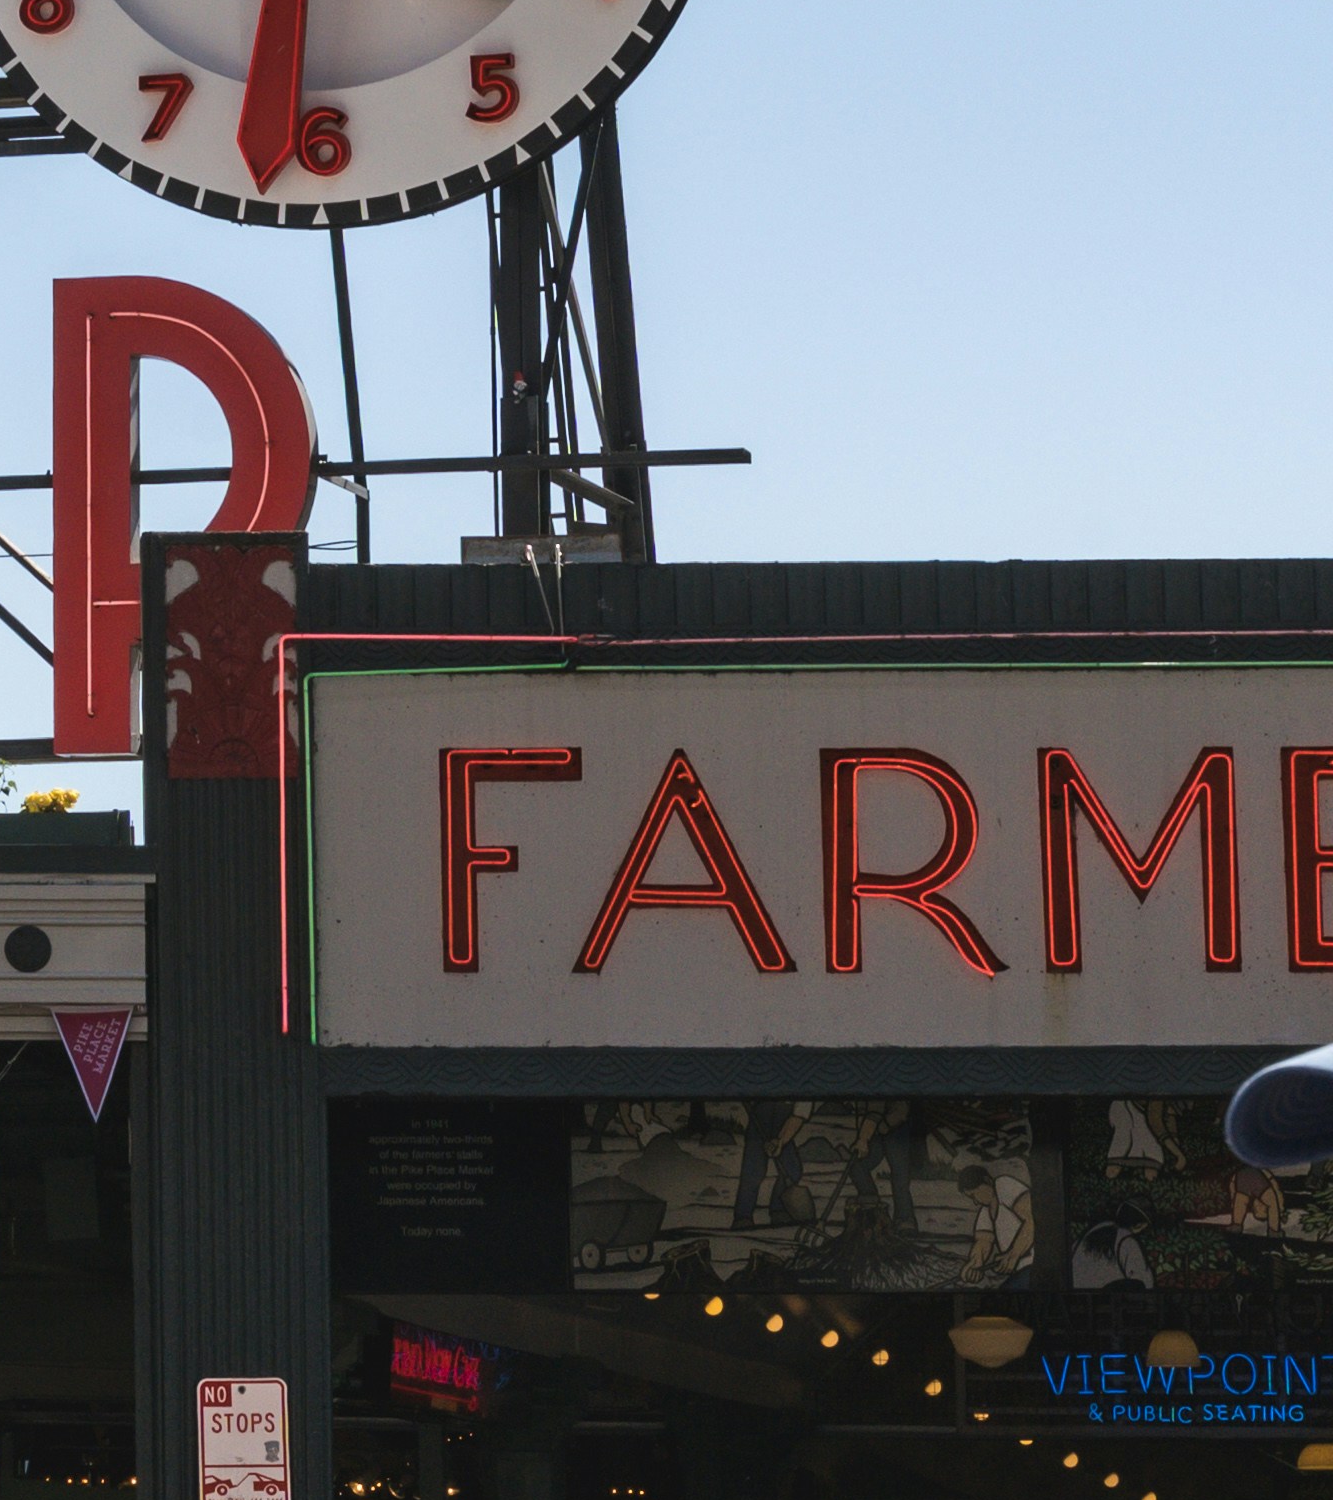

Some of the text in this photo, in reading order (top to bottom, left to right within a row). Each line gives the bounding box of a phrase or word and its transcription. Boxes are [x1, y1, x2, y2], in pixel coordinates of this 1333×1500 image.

[137, 73, 194, 142] 7
[465, 52, 520, 124] 5
[296, 106, 352, 176] 6
[73, 1022, 93, 1054] PIKE
[83, 1021, 108, 1063] PLACE
[93, 1018, 121, 1074] MARKET
[205, 1386, 226, 1402] NO
[1089, 1403, 1305, 1423] & PUBLIC SEATING
[212, 1413, 275, 1433] STOPS
